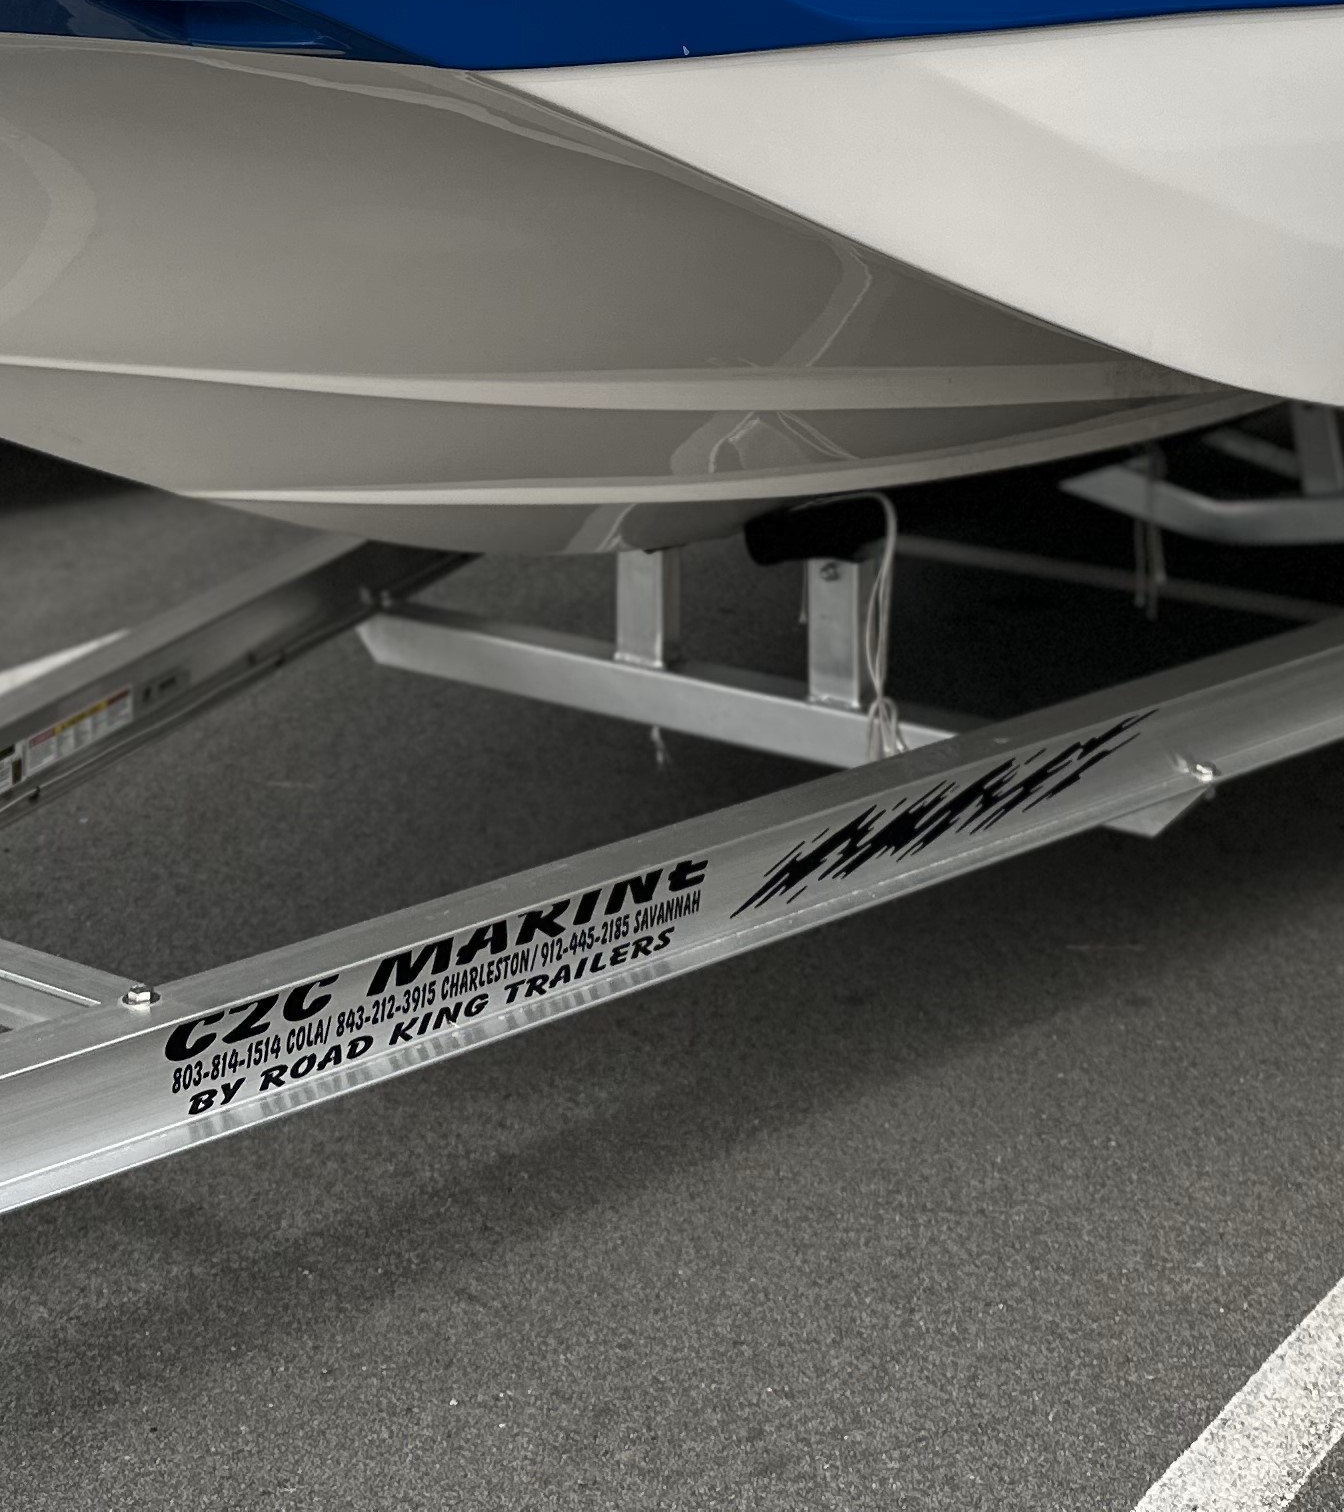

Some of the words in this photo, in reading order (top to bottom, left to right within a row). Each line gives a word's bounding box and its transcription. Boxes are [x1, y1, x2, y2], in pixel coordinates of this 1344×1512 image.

[164, 973, 340, 1062] C2C
[366, 859, 709, 997] MARINE
[172, 1034, 281, 1094] 803-814-1514
[286, 1016, 332, 1054] COLA/
[336, 981, 436, 1037] 843-212-3915
[540, 914, 630, 965] 912-445-2185
[633, 890, 701, 934] SAVANNAH
[188, 1076, 246, 1115] BY
[258, 1035, 374, 1091] ROAD
[388, 993, 489, 1046] KING
[504, 926, 675, 1004] TRAILERS
